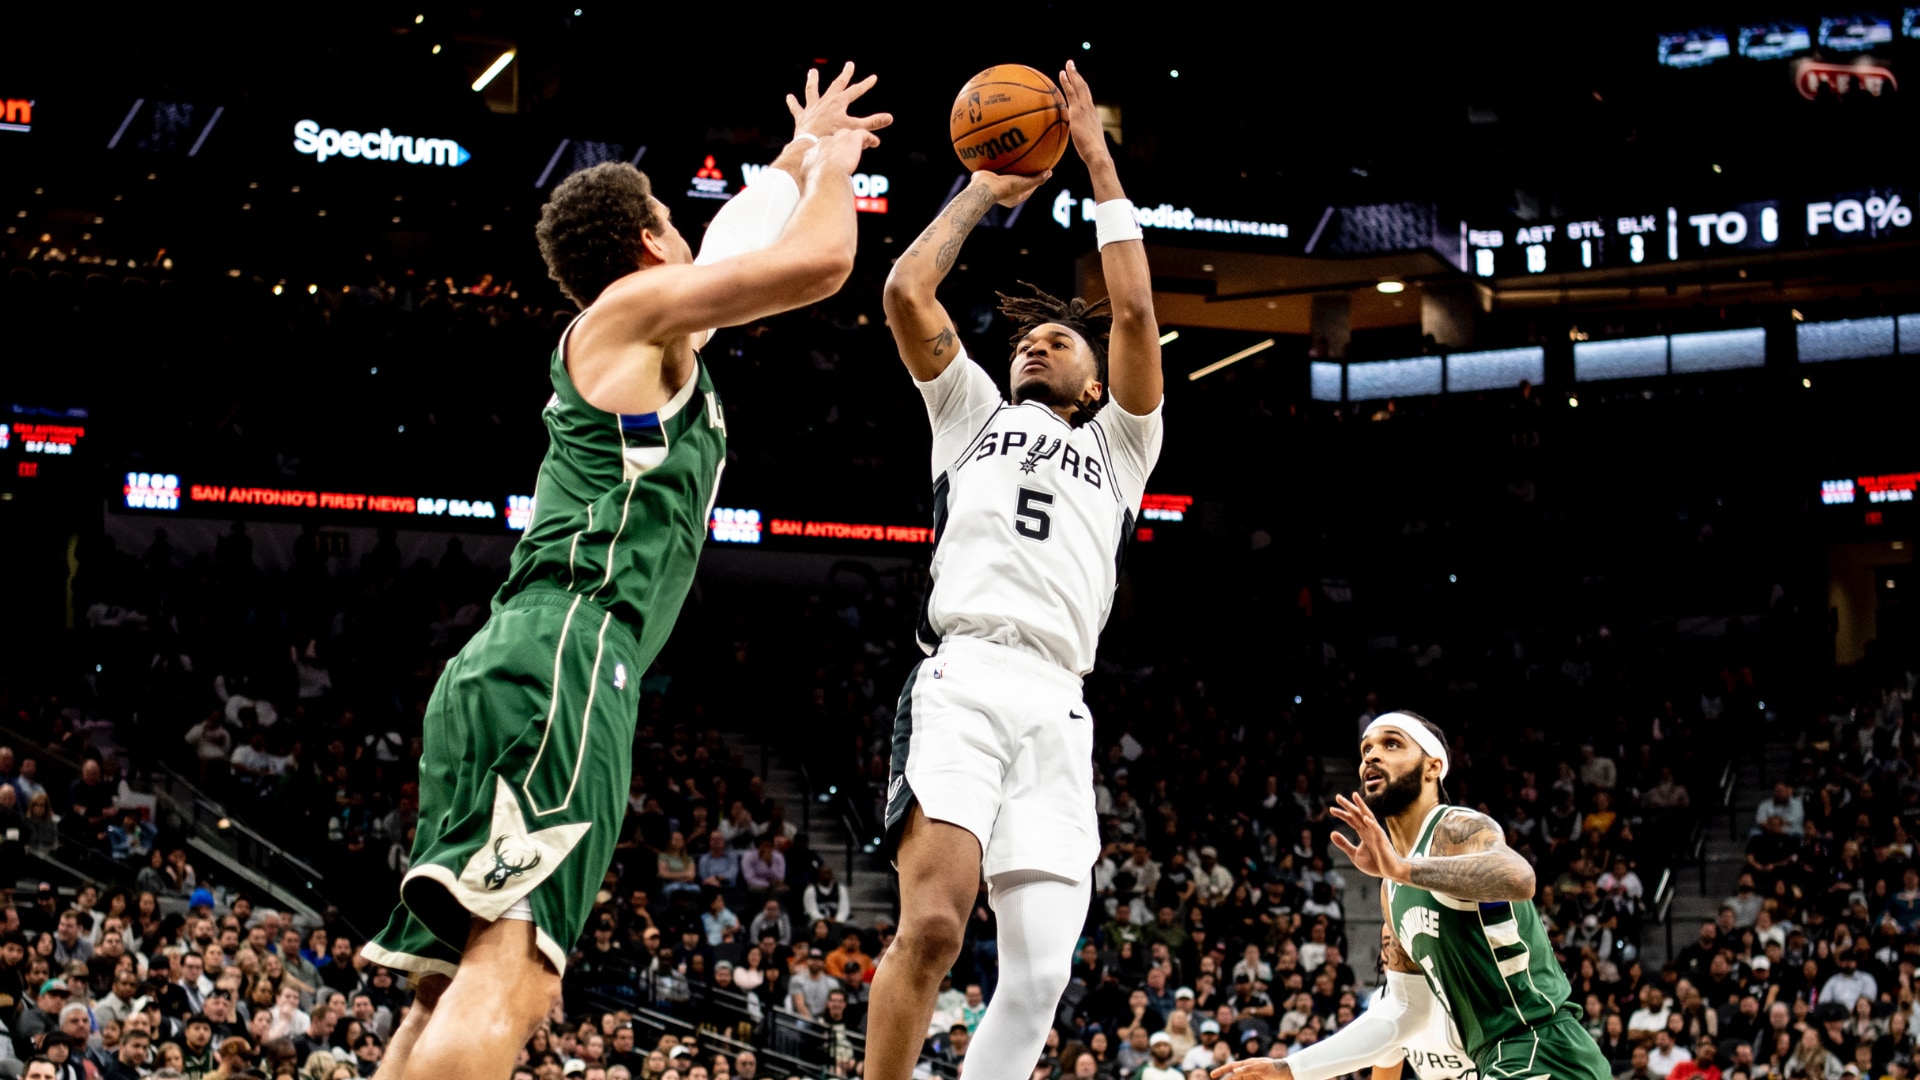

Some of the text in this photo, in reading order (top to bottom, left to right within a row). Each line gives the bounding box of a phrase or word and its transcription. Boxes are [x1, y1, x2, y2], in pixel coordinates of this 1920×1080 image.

[293, 119, 460, 167] Spectrum
[958, 126, 1029, 161] Wilson
[1193, 217, 1289, 238] HEALTHCARE
[1469, 214, 1656, 247] REB AST STL BLK
[1688, 211, 1748, 247] TO
[1807, 194, 1912, 236] FG%
[976, 431, 1102, 490] SPURS
[190, 485, 226, 502] SAN
[228, 487, 317, 507] ANTONIO'S
[319, 492, 366, 510] FIRST
[367, 496, 416, 513] NEWS
[1014, 485, 1056, 543] 5
[770, 518, 802, 535] SAN
[805, 521, 883, 540] ANTONIO'S
[886, 526, 929, 543] FIRST
